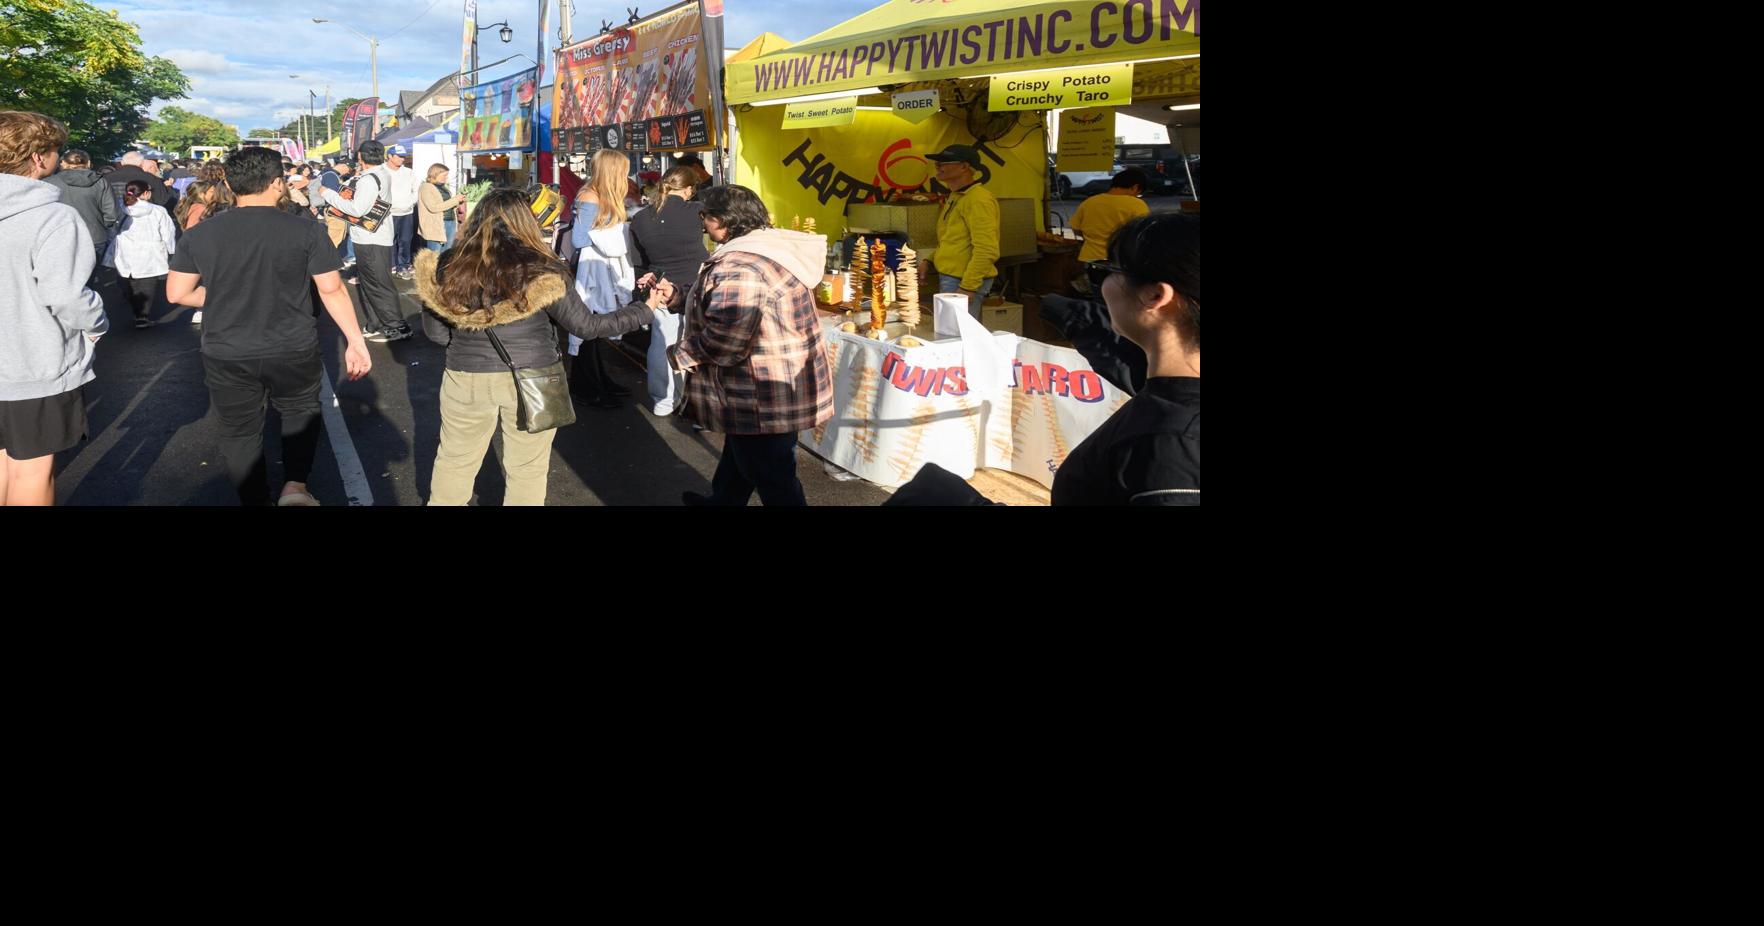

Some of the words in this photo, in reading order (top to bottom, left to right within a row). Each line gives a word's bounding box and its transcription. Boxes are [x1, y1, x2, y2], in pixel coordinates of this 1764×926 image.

[573, 47, 592, 62] Miss
[593, 35, 630, 56] Greasy
[754, 0, 1200, 93] WWW.HAPPYTWISTINC.COM
[1006, 80, 1050, 92] Crispy
[1062, 75, 1111, 88] Potato
[897, 99, 933, 111] ORDER
[1006, 94, 1064, 107] Crunchy
[1076, 91, 1109, 102] Taro
[787, 111, 805, 119] Twist
[807, 108, 828, 118] Sweet
[831, 104, 854, 116] Potato
[881, 351, 969, 397] TWIS
